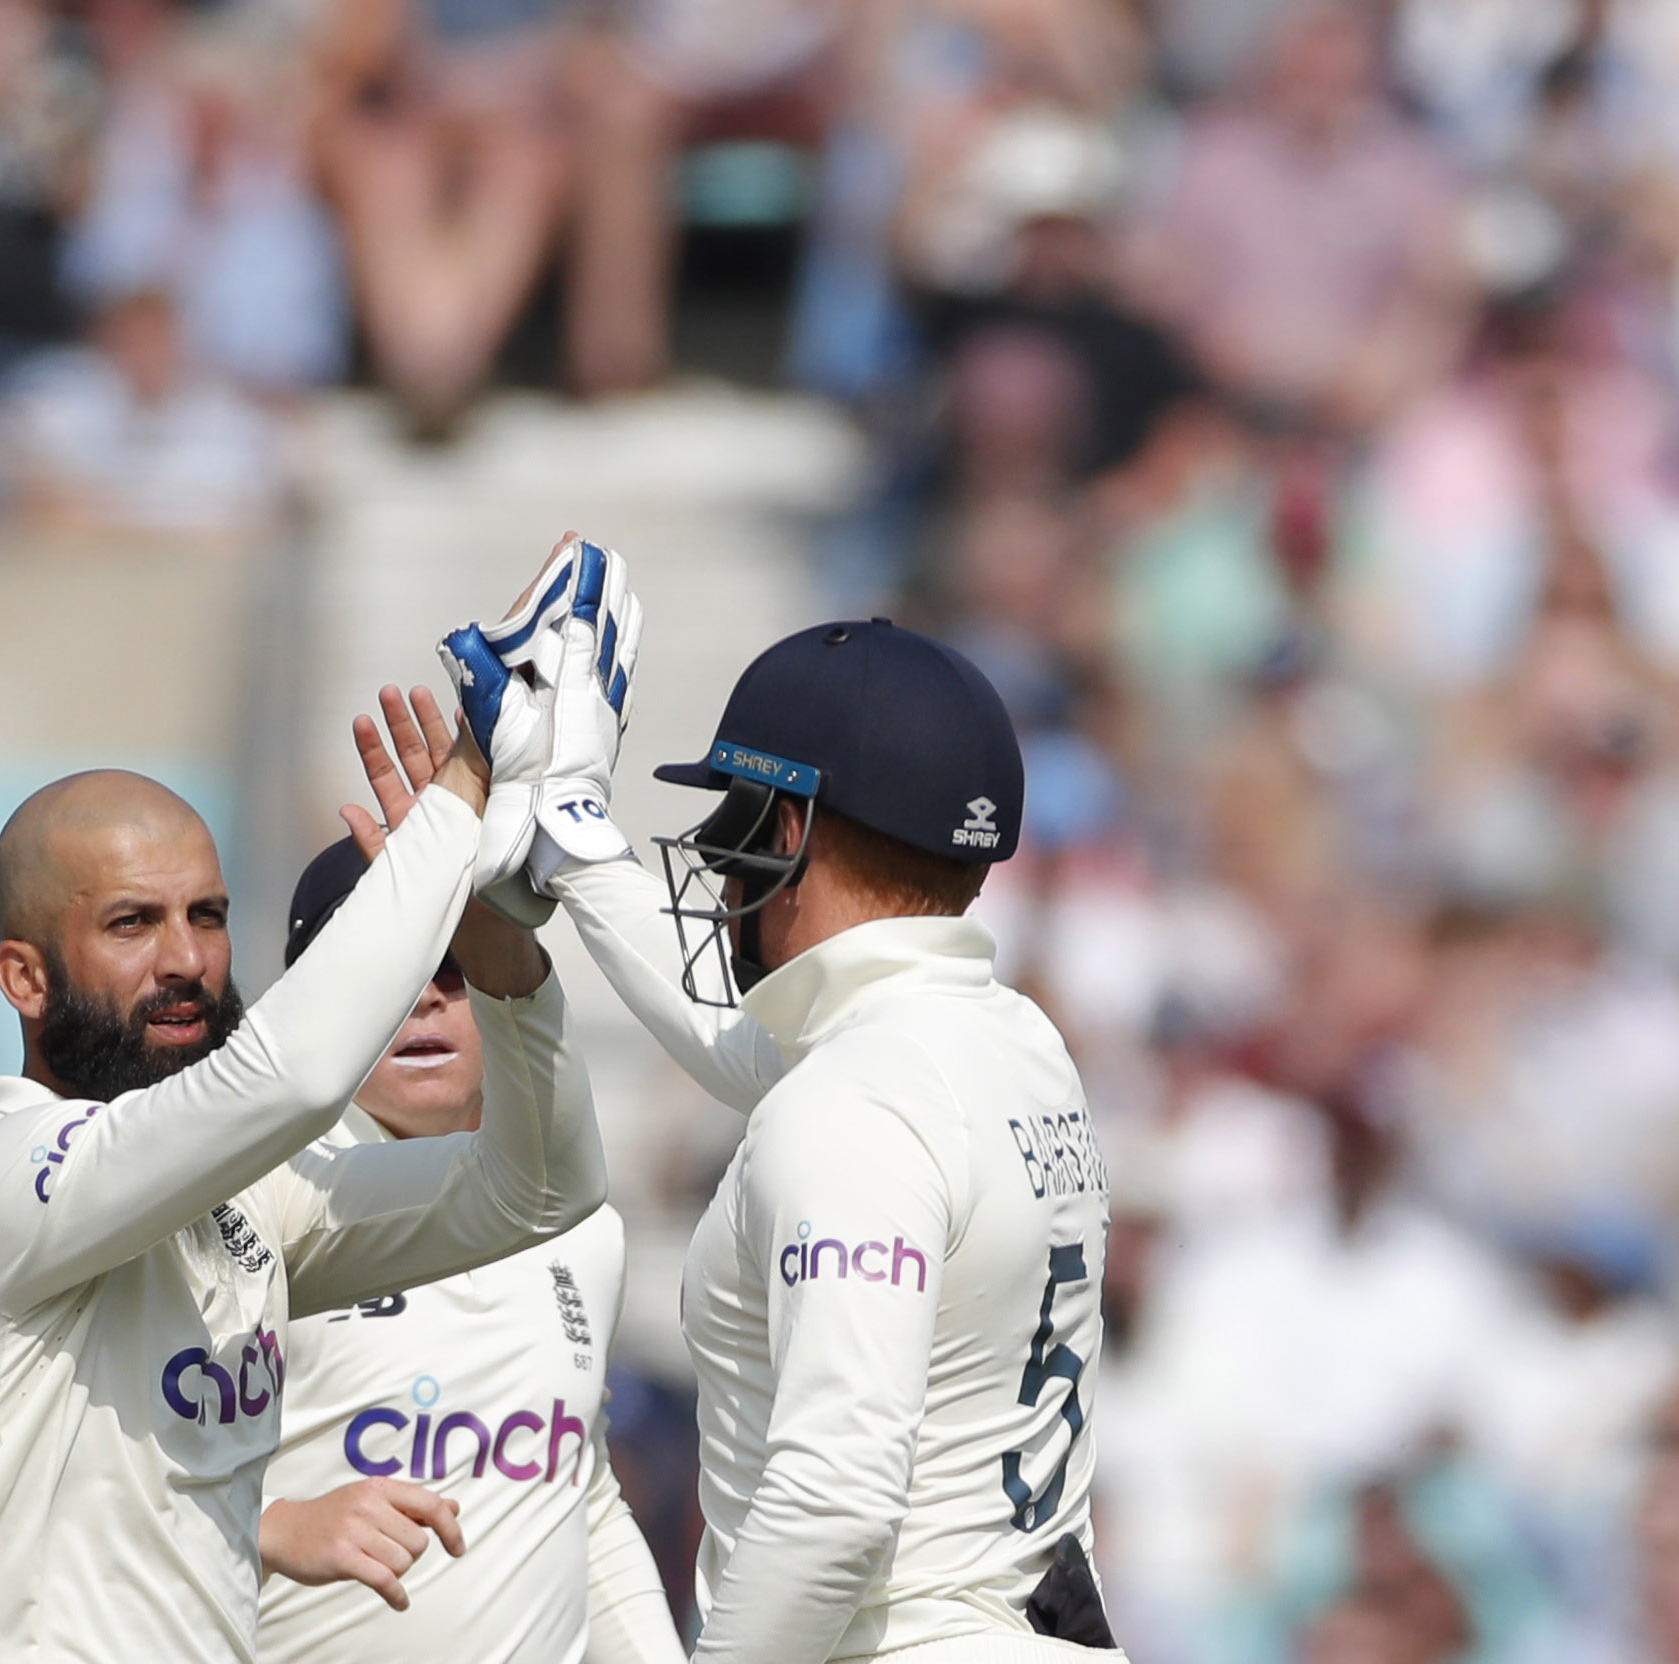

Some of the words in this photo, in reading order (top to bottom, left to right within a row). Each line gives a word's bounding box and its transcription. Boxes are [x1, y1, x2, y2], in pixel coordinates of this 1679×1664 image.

[732, 750, 783, 777] SHREY
[951, 828, 1001, 848] SHREY
[779, 1219, 927, 1293] cinch
[1001, 1242, 1105, 1534] 5
[343, 1373, 587, 1488] cinch
